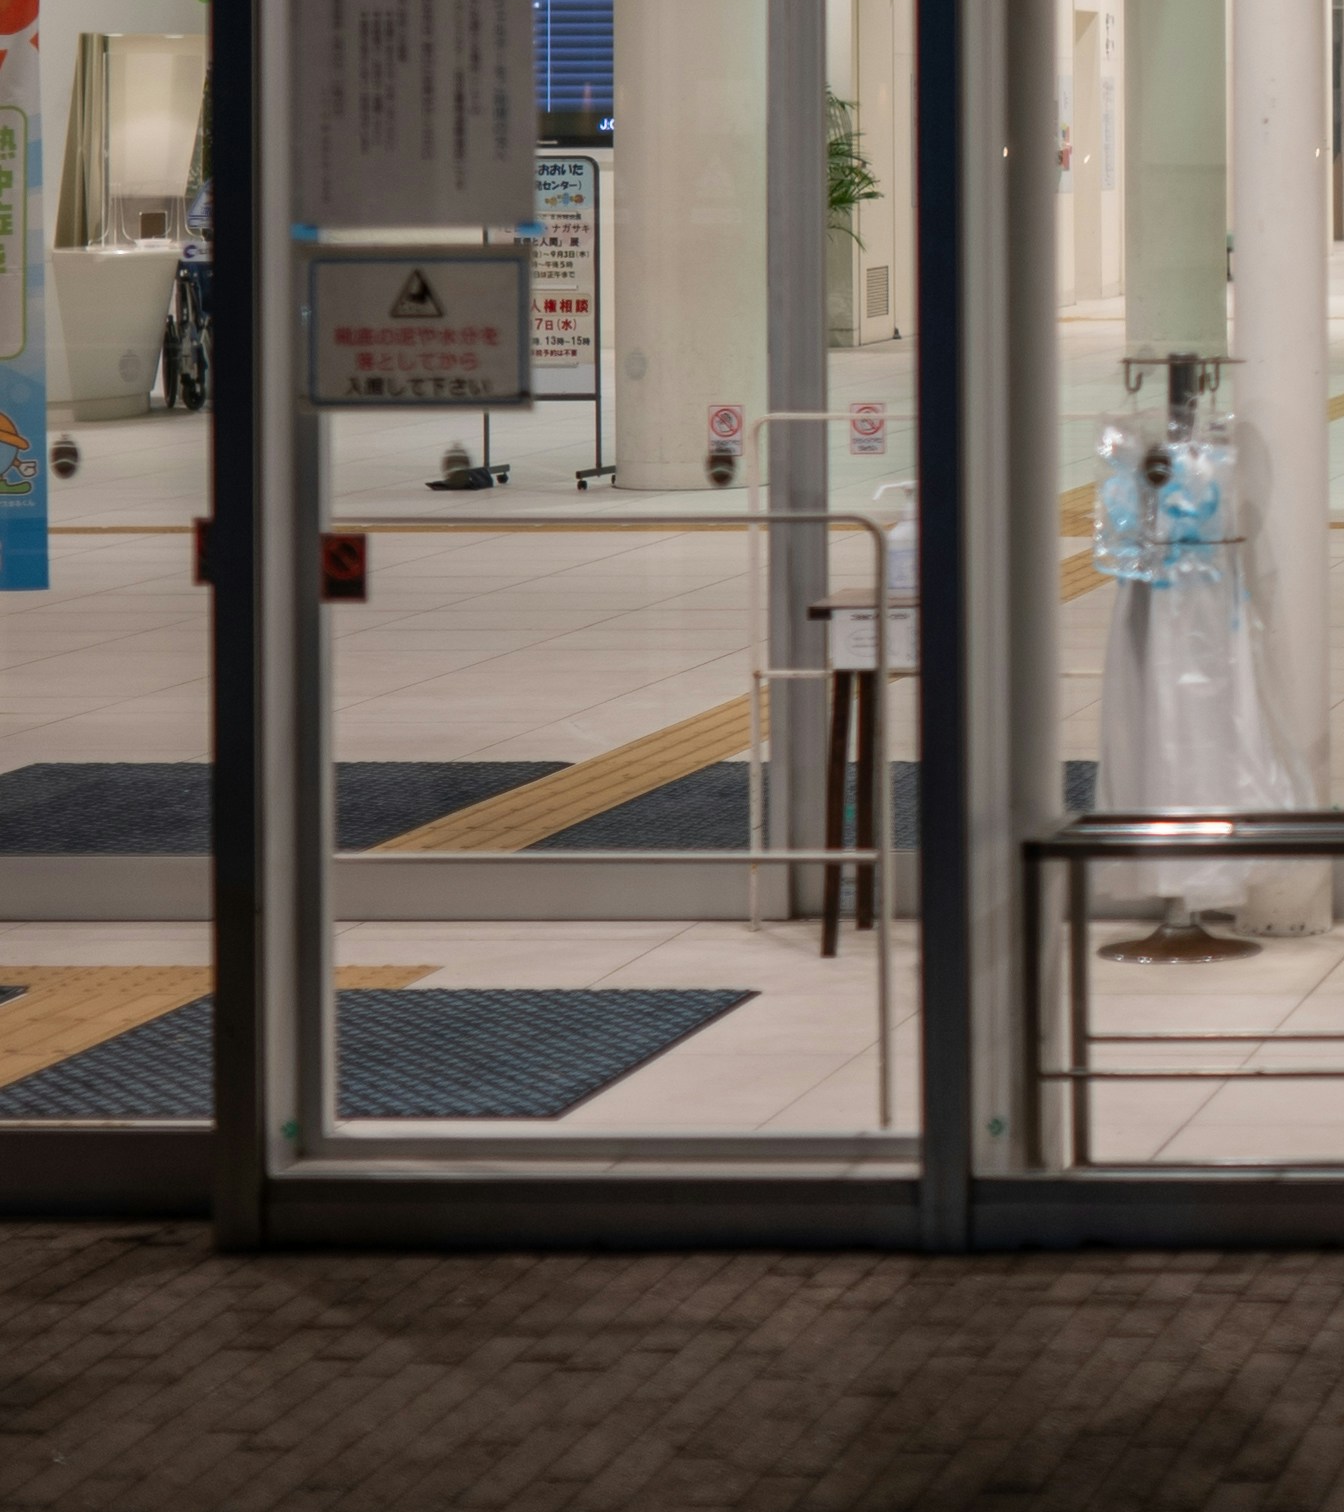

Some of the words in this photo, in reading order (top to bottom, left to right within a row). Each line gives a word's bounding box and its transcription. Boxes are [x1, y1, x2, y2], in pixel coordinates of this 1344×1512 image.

[535, 163, 584, 176] おおいた
[531, 298, 589, 313] 人権相談
